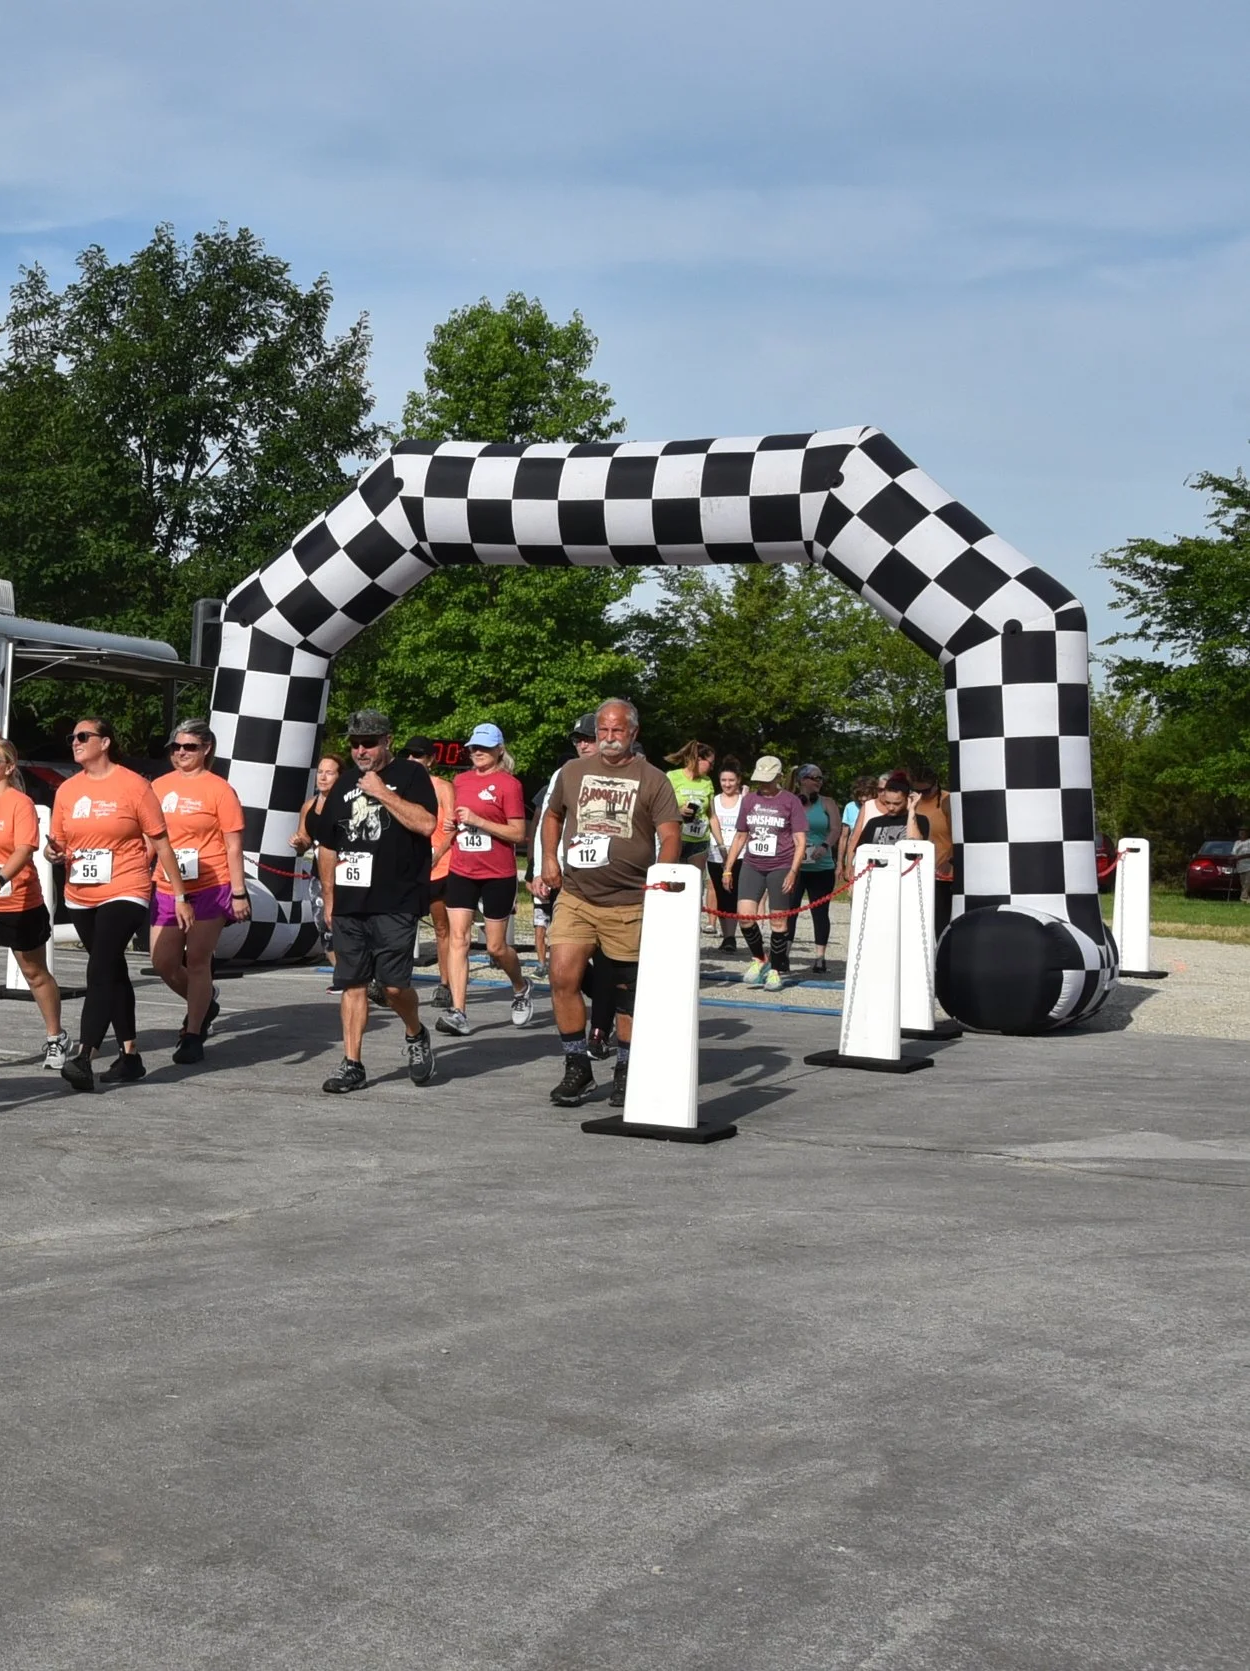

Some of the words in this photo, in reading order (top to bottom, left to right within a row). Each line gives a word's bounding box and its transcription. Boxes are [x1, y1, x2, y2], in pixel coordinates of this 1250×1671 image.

[579, 786, 638, 811] BROOKLYN
[746, 815, 785, 828] SUNSHINE
[464, 835, 482, 847] 143
[755, 842, 769, 853] 109
[579, 849, 597, 862] 112
[82, 864, 98, 878] 55
[346, 867, 360, 881] 65
